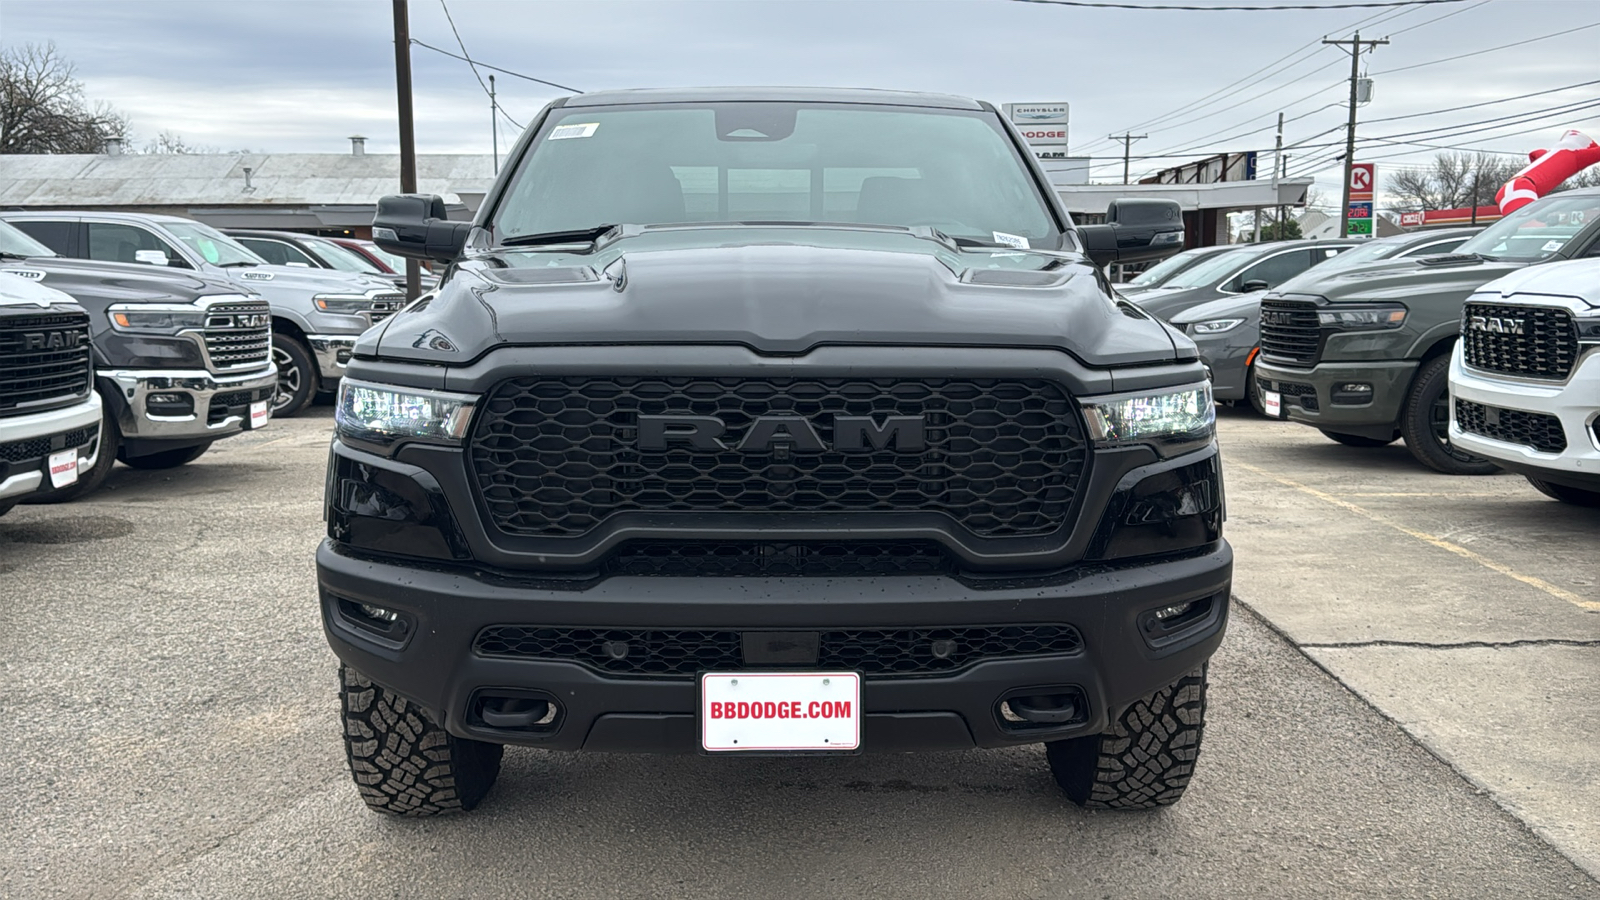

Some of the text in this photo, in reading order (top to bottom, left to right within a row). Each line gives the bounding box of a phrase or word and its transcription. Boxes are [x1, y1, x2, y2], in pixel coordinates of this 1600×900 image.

[1353, 171, 1369, 188] K
[1469, 315, 1525, 335] RAM
[23, 330, 80, 350] RAM
[637, 413, 926, 450] RAM
[710, 701, 851, 719] BBDODGE.COM
